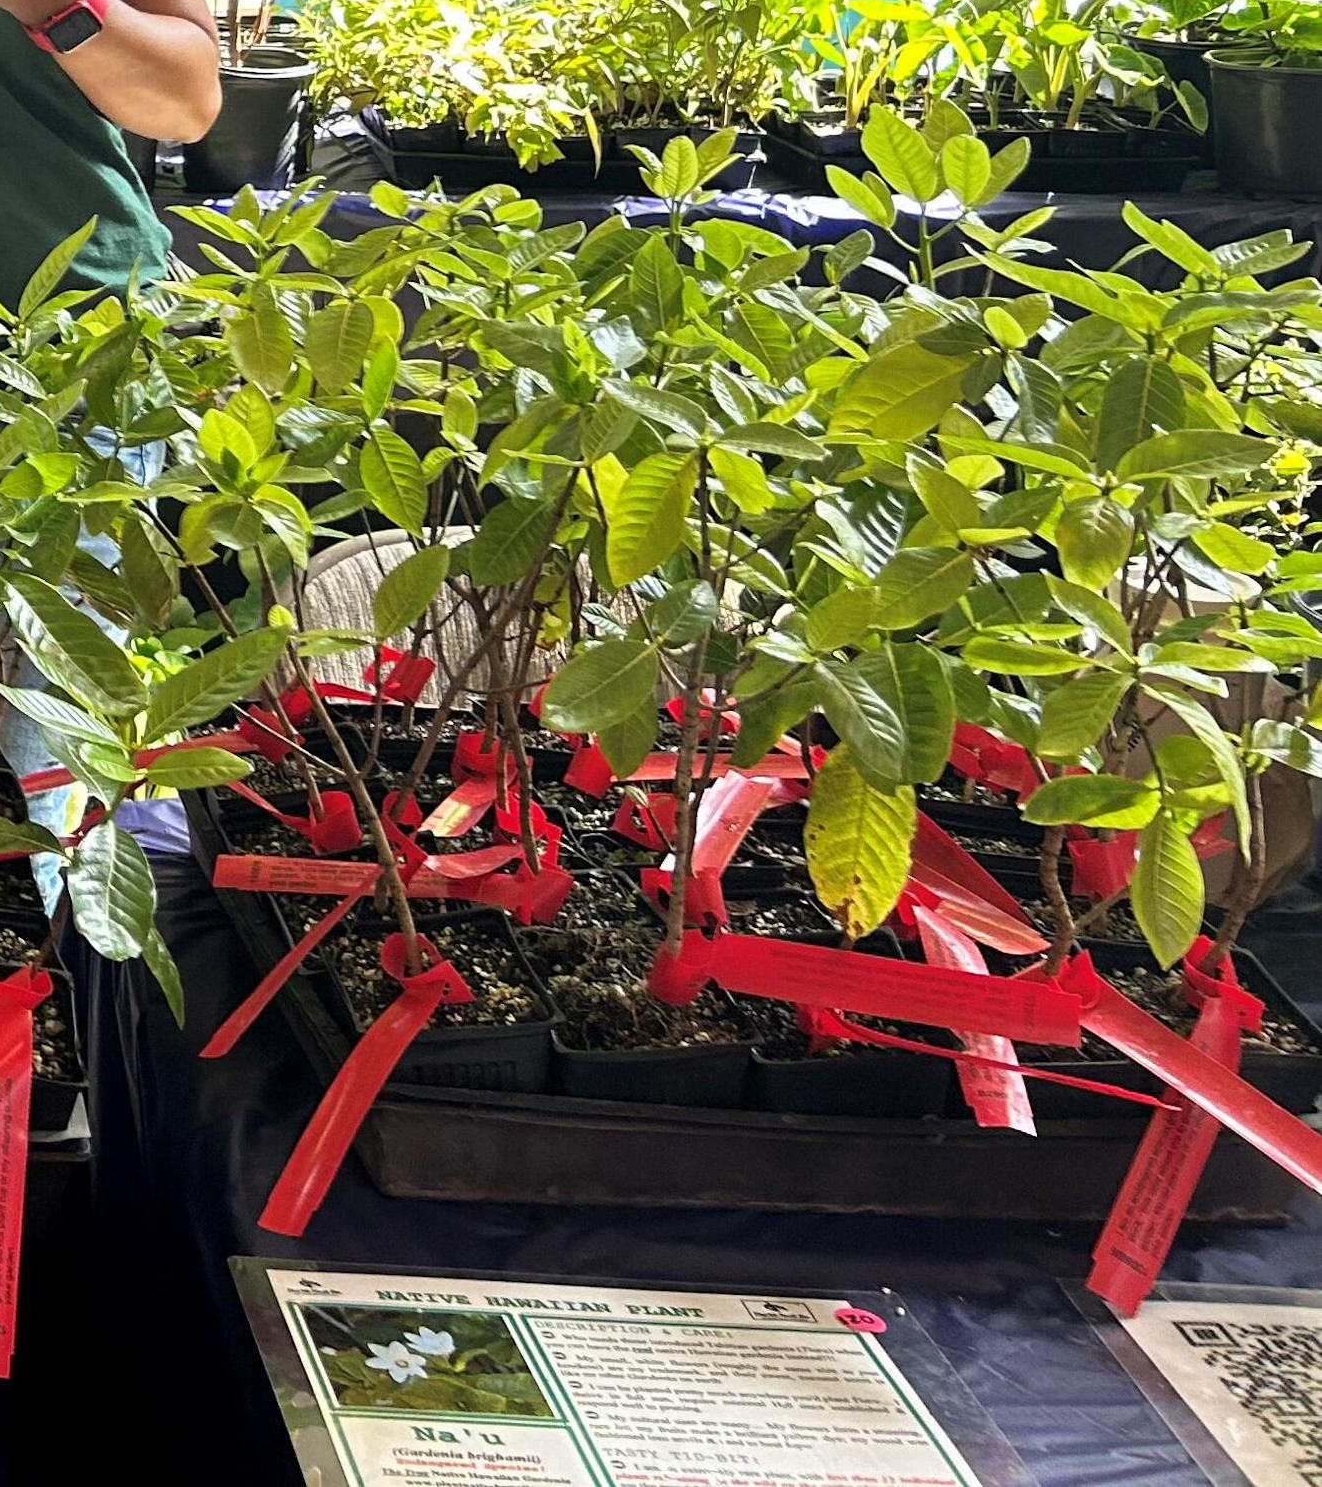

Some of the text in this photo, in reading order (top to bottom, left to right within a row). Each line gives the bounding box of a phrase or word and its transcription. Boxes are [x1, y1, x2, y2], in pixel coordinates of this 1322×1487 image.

[376, 1289, 704, 1318] NATIVE HAWAIIAN PLANT
[535, 1320, 650, 1335] DESCRIPTION
[681, 1329, 734, 1339] CARE:
[412, 1426, 507, 1446] Na'u
[603, 1447, 760, 1465] TASTY TID-BIT:
